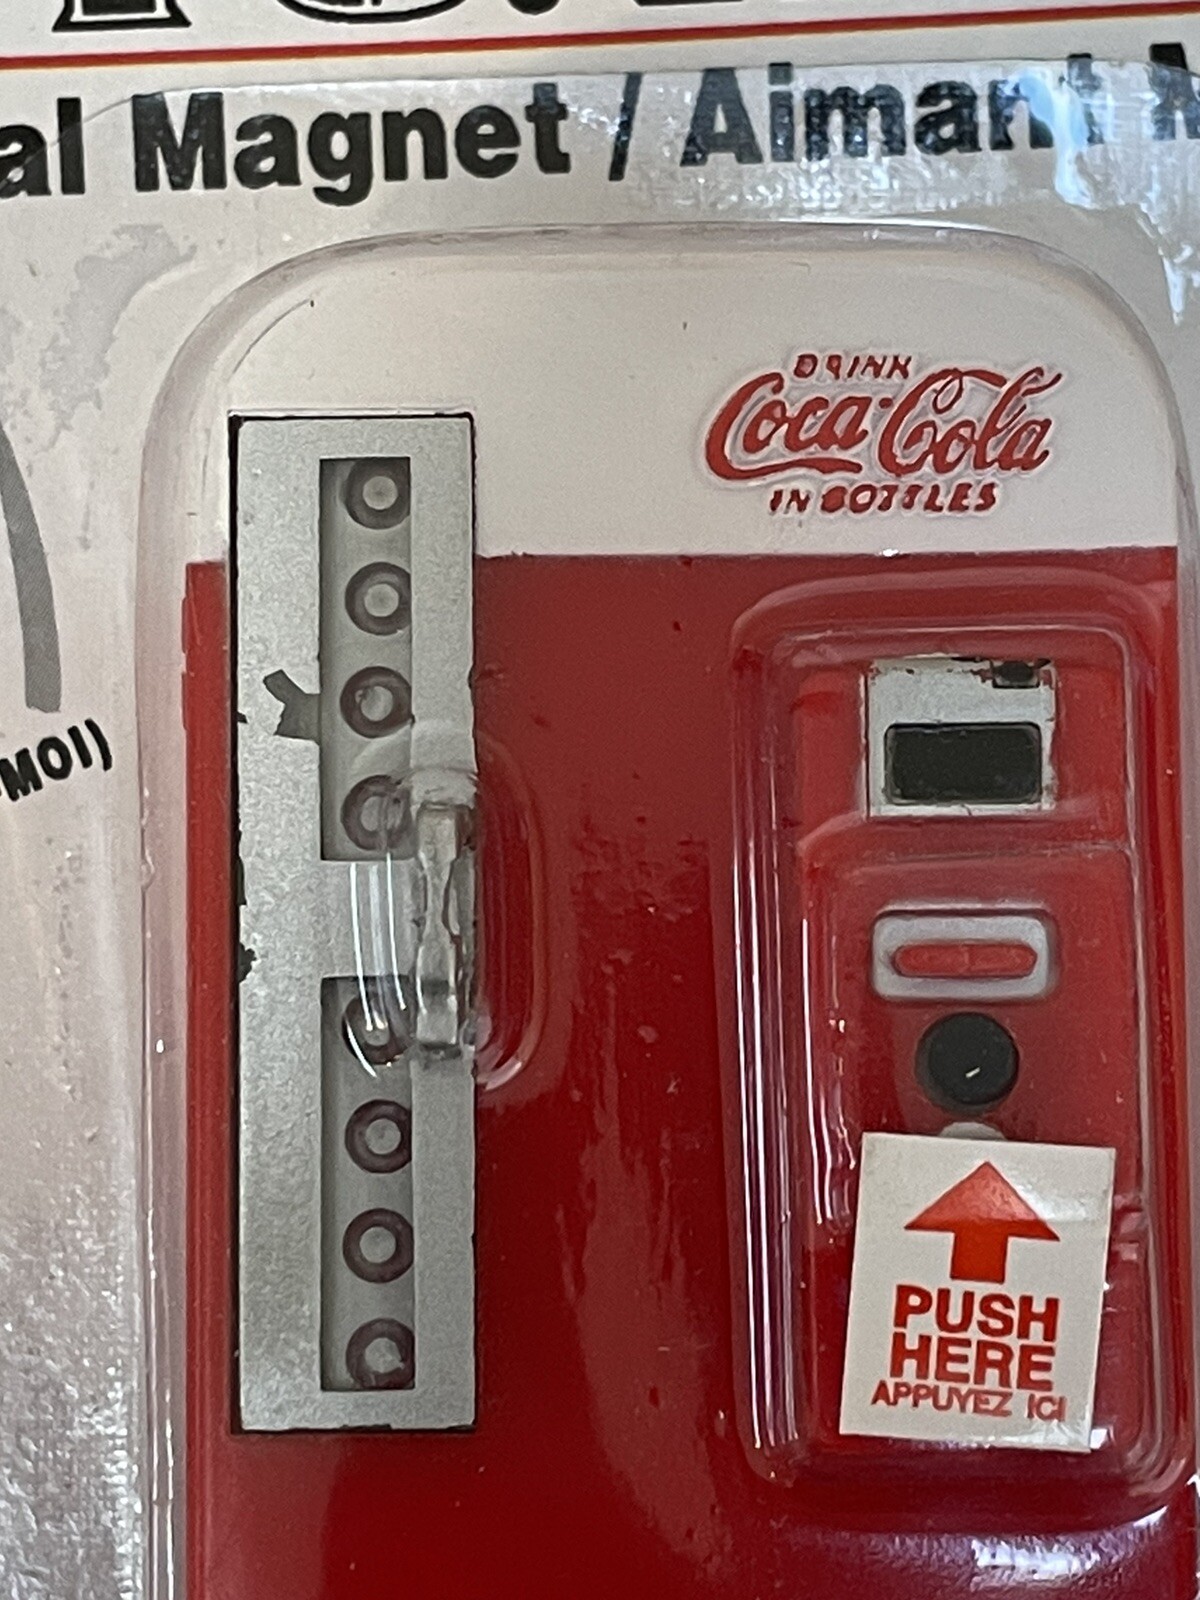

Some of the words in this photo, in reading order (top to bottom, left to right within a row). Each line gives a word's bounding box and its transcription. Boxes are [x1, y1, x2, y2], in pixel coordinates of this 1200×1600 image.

[0, 97, 85, 197] al
[131, 82, 571, 206] Magnet
[608, 71, 643, 181] /
[793, 353, 913, 381] DRINK
[704, 366, 1063, 482] Coca-Cola
[769, 488, 812, 514] IN
[820, 482, 998, 514] BOTTLES
[0, 717, 113, 802] MOI)
[893, 1283, 1060, 1343] PUSH
[889, 1331, 1056, 1393] HERE
[870, 1380, 1014, 1418] APPUYEZ
[1026, 1393, 1069, 1423] ICI
